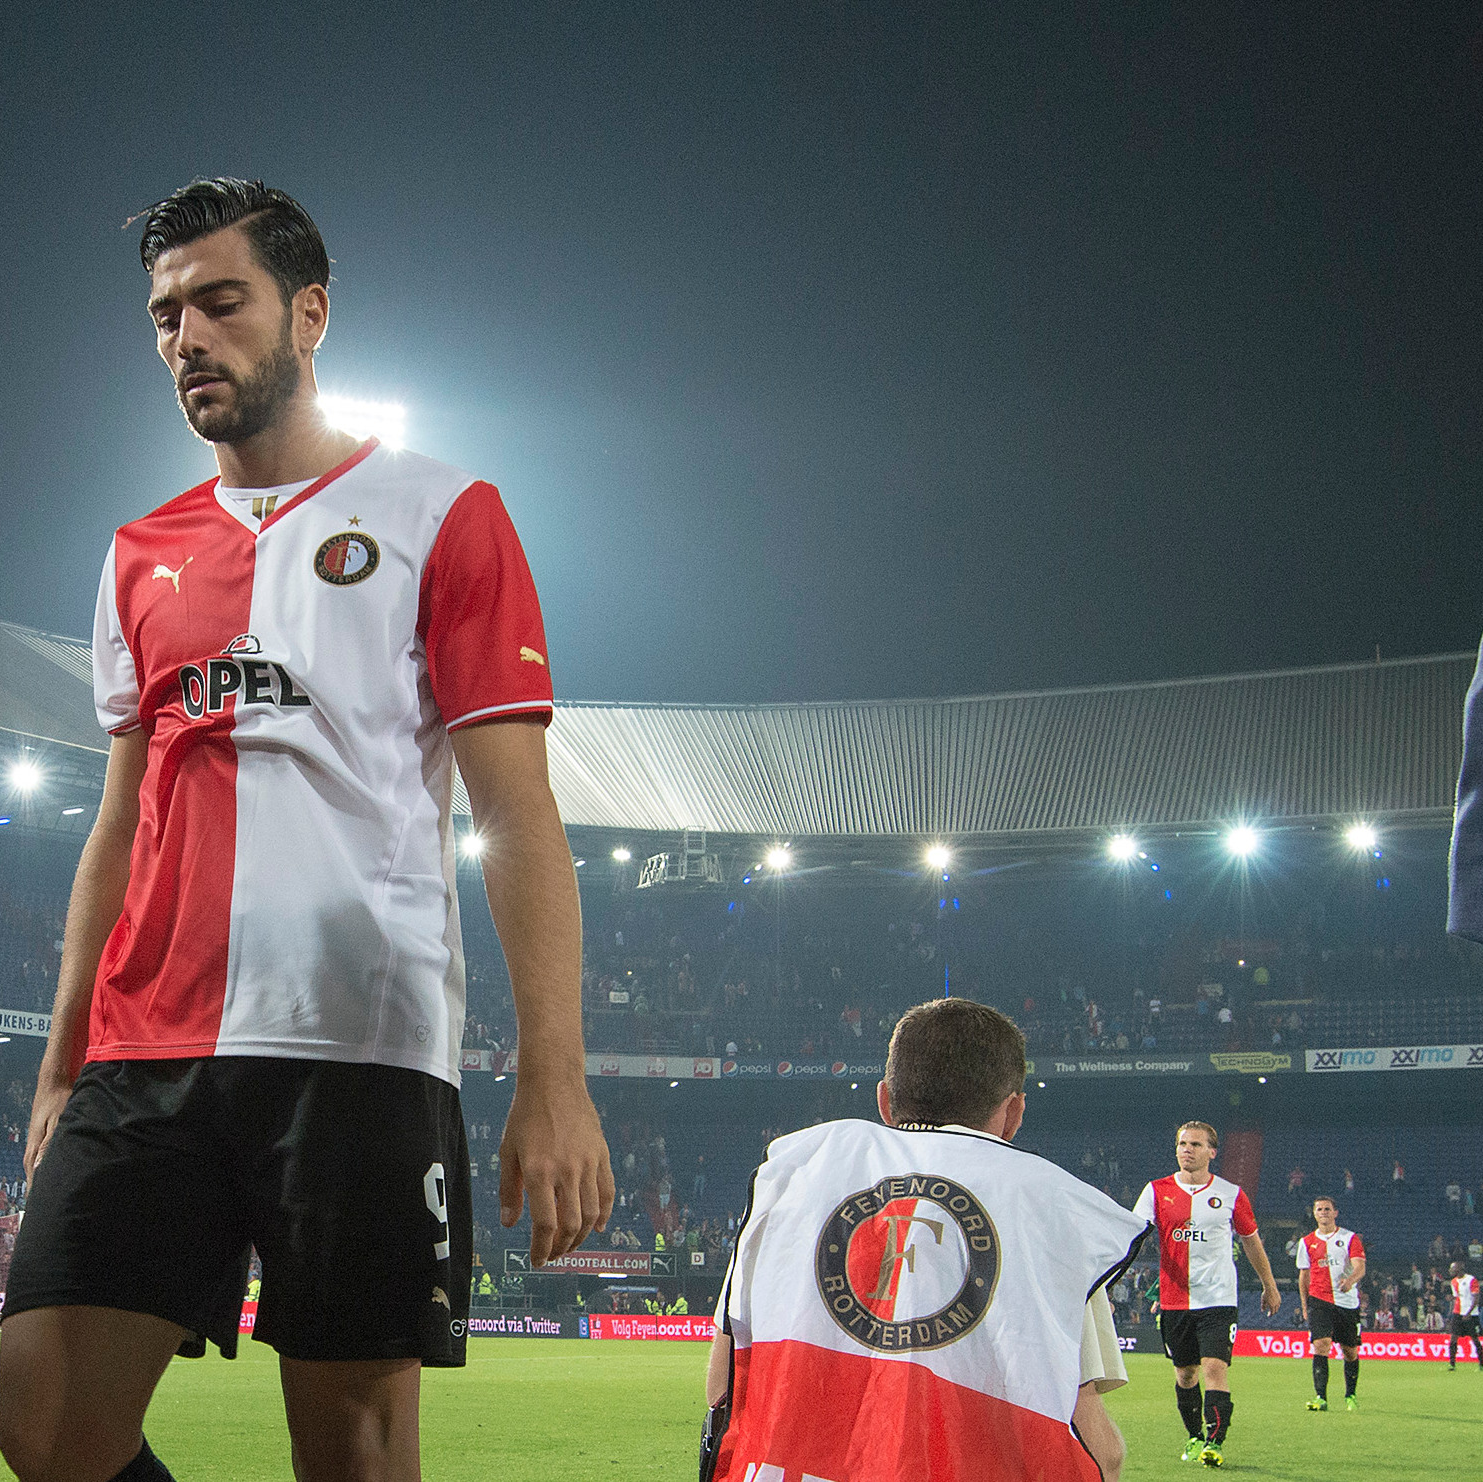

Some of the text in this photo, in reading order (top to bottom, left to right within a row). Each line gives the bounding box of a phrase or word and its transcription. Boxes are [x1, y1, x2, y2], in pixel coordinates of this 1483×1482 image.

[178, 658, 313, 719] OPEL
[740, 1064, 772, 1074] pepsi
[794, 1064, 827, 1075] pepsi
[849, 1064, 882, 1075] pepsi
[1055, 1061, 1190, 1072] The Wellness Company
[424, 1163, 450, 1260] 9
[840, 1178, 991, 1252] FEYENOORD
[1173, 1229, 1208, 1242] OPEL
[694, 1255, 702, 1263] D
[867, 1215, 945, 1300] F
[824, 1275, 974, 1346] ROTTERDAM
[506, 1315, 523, 1332] via
[524, 1316, 561, 1334] Twitter
[611, 1319, 717, 1339] Volg Feyenoord via
[1256, 1336, 1305, 1359] Volg
